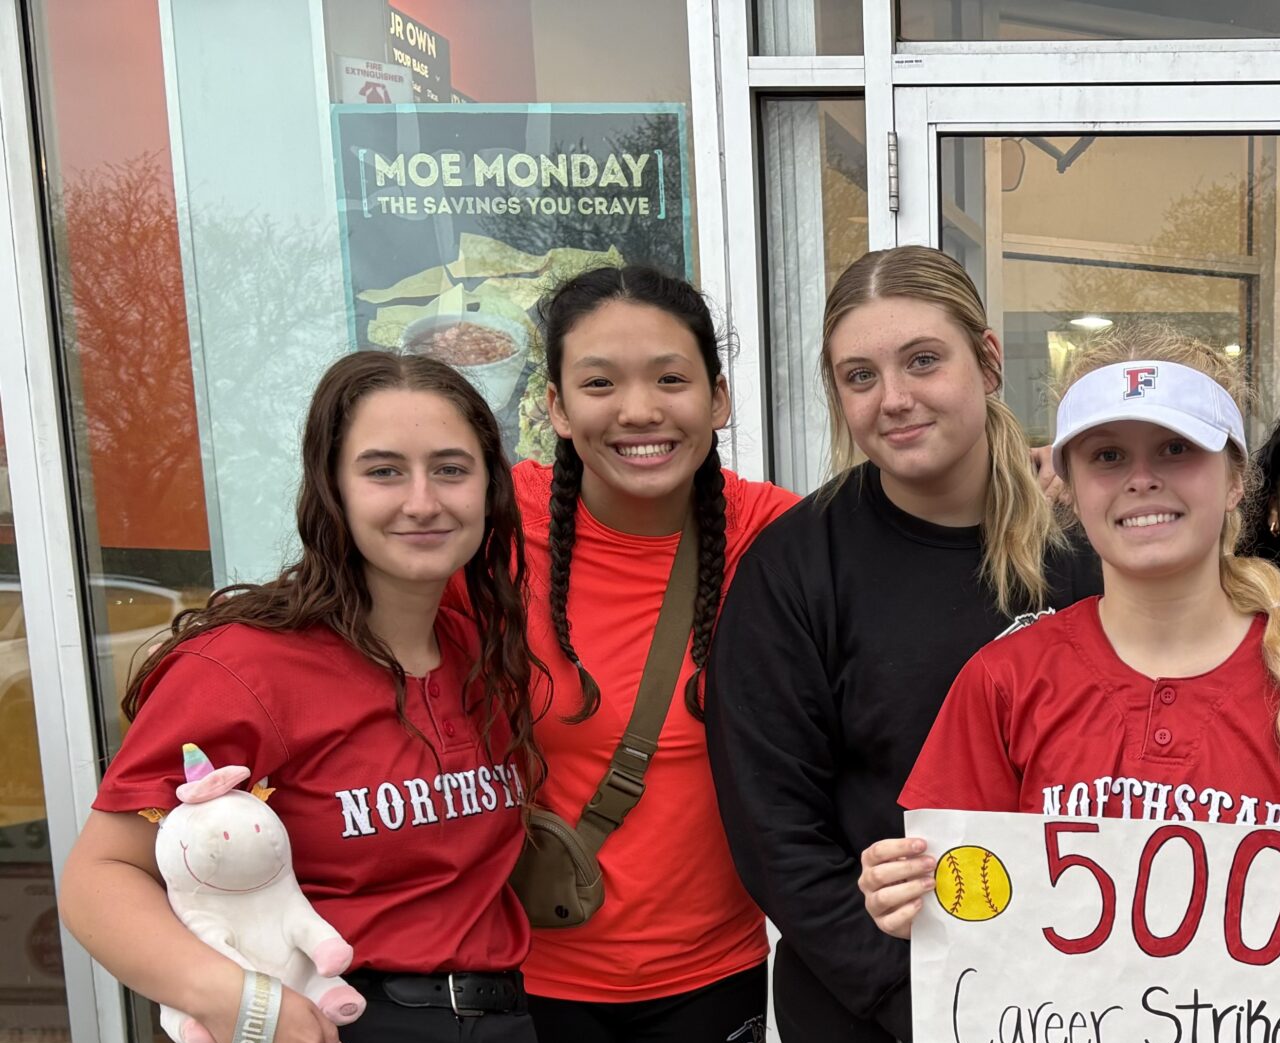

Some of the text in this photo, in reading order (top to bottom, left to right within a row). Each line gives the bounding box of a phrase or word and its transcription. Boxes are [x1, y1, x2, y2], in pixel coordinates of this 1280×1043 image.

[406, 22, 437, 59] OWN
[345, 66, 404, 83] EXTINGUISHER
[366, 61, 383, 72] FIRE
[393, 47, 429, 78] YOUR BASE
[375, 153, 650, 187] MOE MONDAY
[378, 197, 650, 215] THE SAVINGS YOU CRAVE
[1123, 366, 1158, 400] F
[335, 763, 526, 838] NORTHSTA
